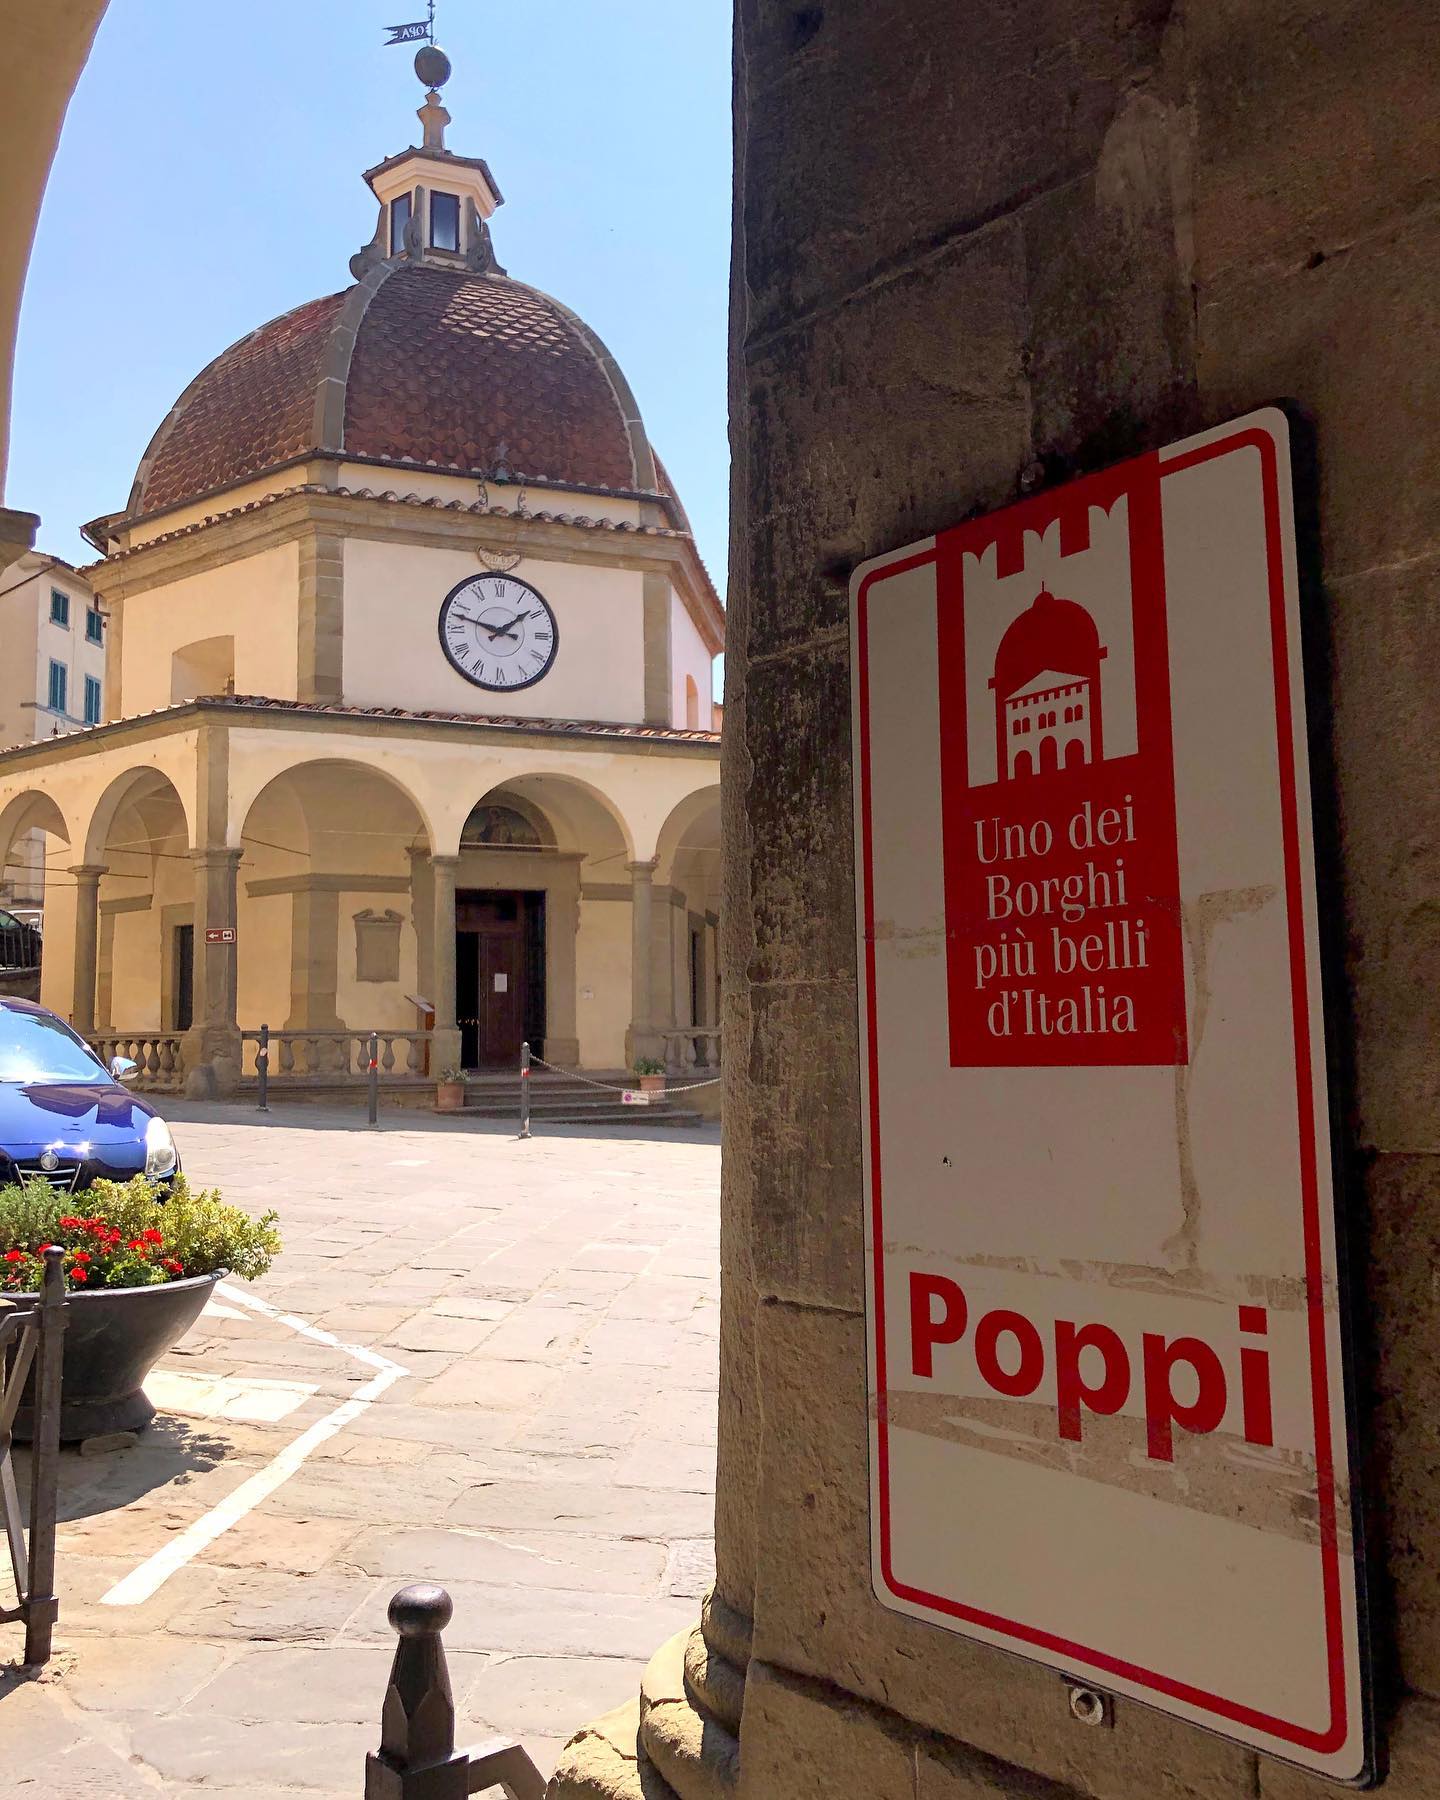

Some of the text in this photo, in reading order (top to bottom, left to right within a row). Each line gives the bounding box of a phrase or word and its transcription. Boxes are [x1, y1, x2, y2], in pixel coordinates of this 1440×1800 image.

[974, 794, 1137, 864] Uno dei
[985, 858, 1129, 923] Borghi
[973, 919, 1149, 990] più belli
[987, 985, 1138, 1037] d'Italia
[909, 1271, 1274, 1463] Poppi
